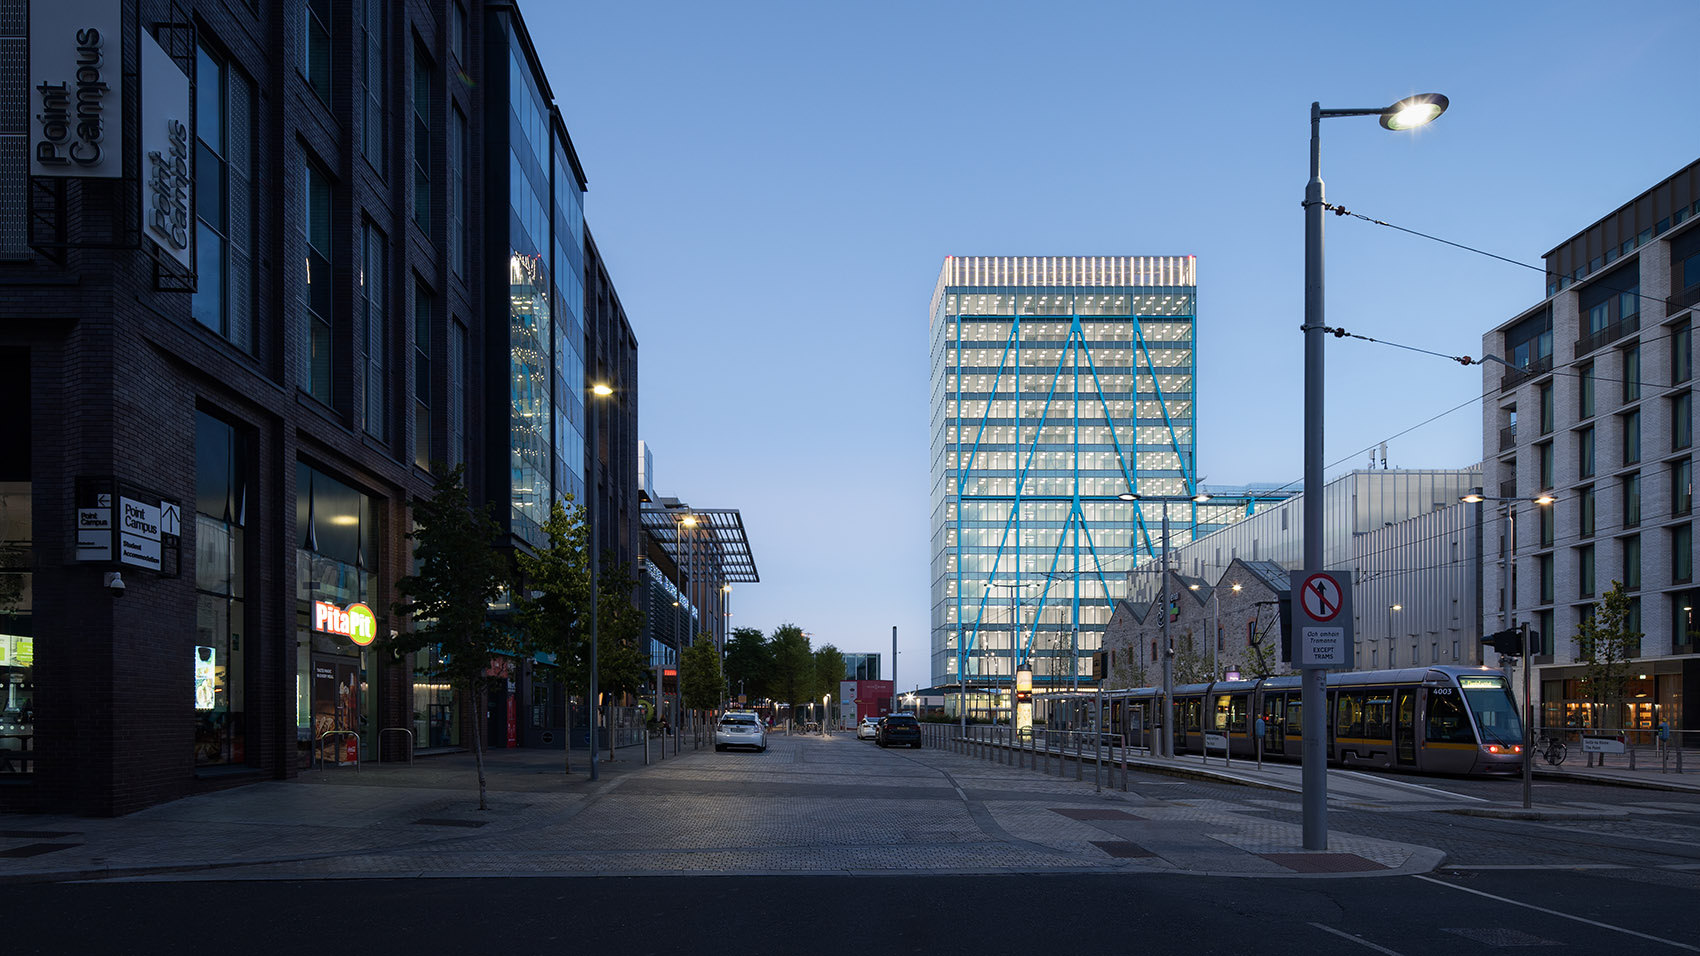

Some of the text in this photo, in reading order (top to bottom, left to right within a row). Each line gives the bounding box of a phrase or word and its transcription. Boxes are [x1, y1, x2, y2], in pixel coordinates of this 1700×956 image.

[69, 28, 108, 166] Campus
[36, 80, 69, 165] Point
[150, 151, 171, 239] Point
[168, 120, 190, 250] Campus
[80, 512, 98, 520] Point
[125, 503, 145, 520] Point
[80, 519, 108, 527] Campus
[125, 515, 158, 535] Campus
[123, 540, 142, 551] Student
